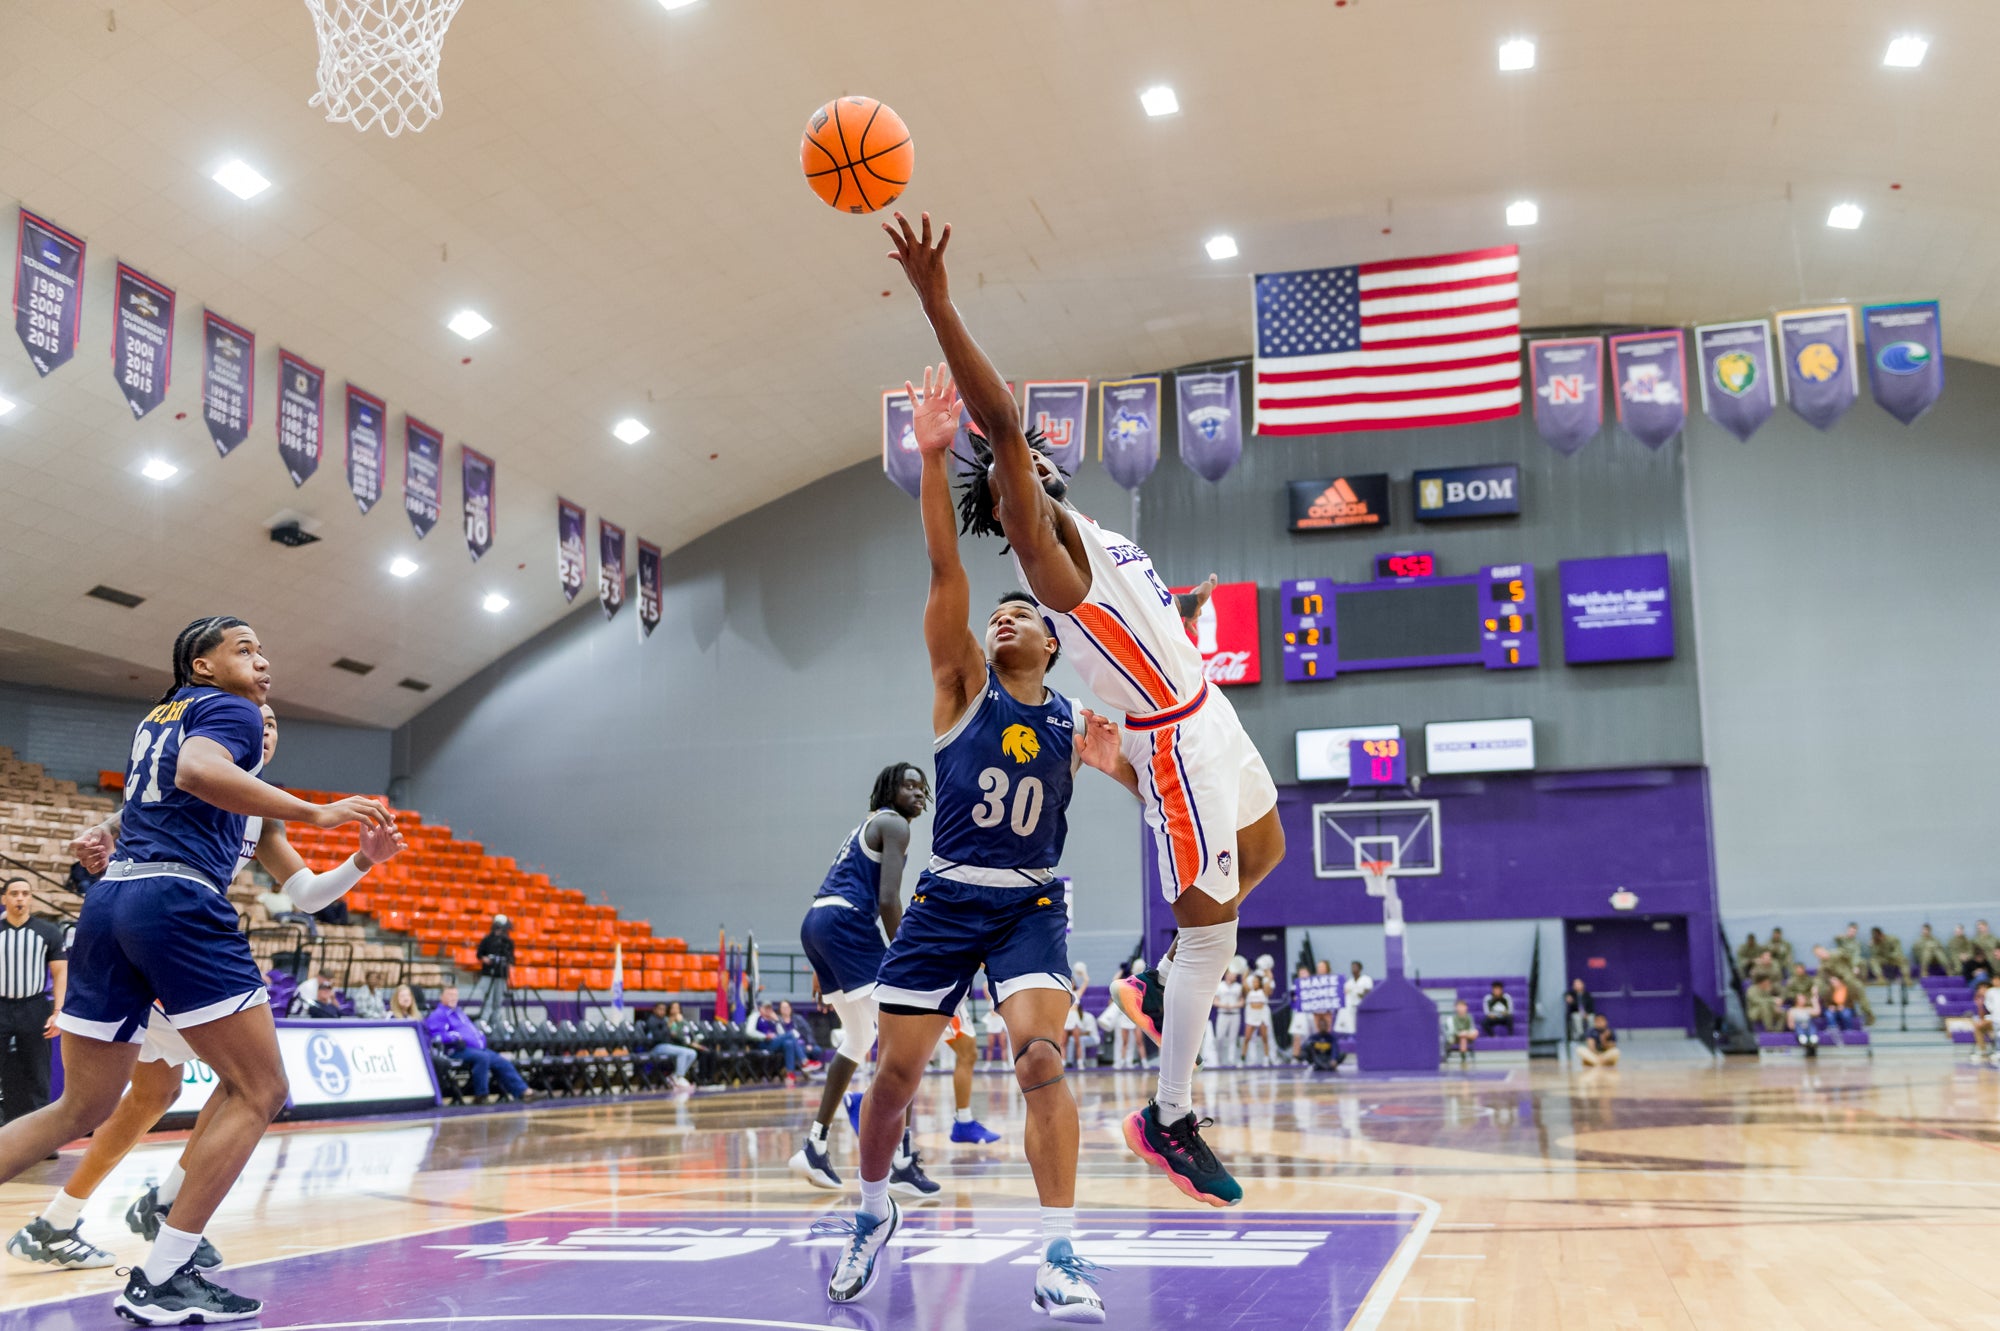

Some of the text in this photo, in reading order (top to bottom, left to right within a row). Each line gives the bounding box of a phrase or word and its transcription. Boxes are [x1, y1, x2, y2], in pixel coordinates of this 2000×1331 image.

[23, 255, 75, 287] TOURNAMENT
[33, 276, 64, 302] 1989
[29, 293, 62, 320] 2004
[28, 310, 60, 336] 2014
[121, 307, 167, 337] TOURNAMENT
[122, 319, 163, 346] CHAMPIONS
[27, 327, 60, 354] 2015
[126, 336, 154, 362] 2004
[126, 353, 153, 377] 2014
[124, 369, 152, 394] 2015
[1446, 478, 1513, 503] BOM
[1308, 500, 1368, 518] adidas
[467, 515, 488, 546] 10
[559, 559, 580, 587] 25
[1388, 555, 1433, 577] 9:53
[600, 578, 620, 605] 33
[1508, 580, 1526, 602] 5
[638, 597, 659, 622] 45
[1303, 594, 1323, 615] 17
[1307, 628, 1319, 646] 2
[1363, 739, 1399, 757] 9:53
[125, 728, 173, 803] 21
[1371, 757, 1392, 782] 10
[972, 767, 1044, 837] 30
[1300, 975, 1339, 989] MAKE
[1300, 986, 1339, 1001] SOME
[1301, 998, 1341, 1013] NOISE
[352, 1046, 398, 1074] Graf
